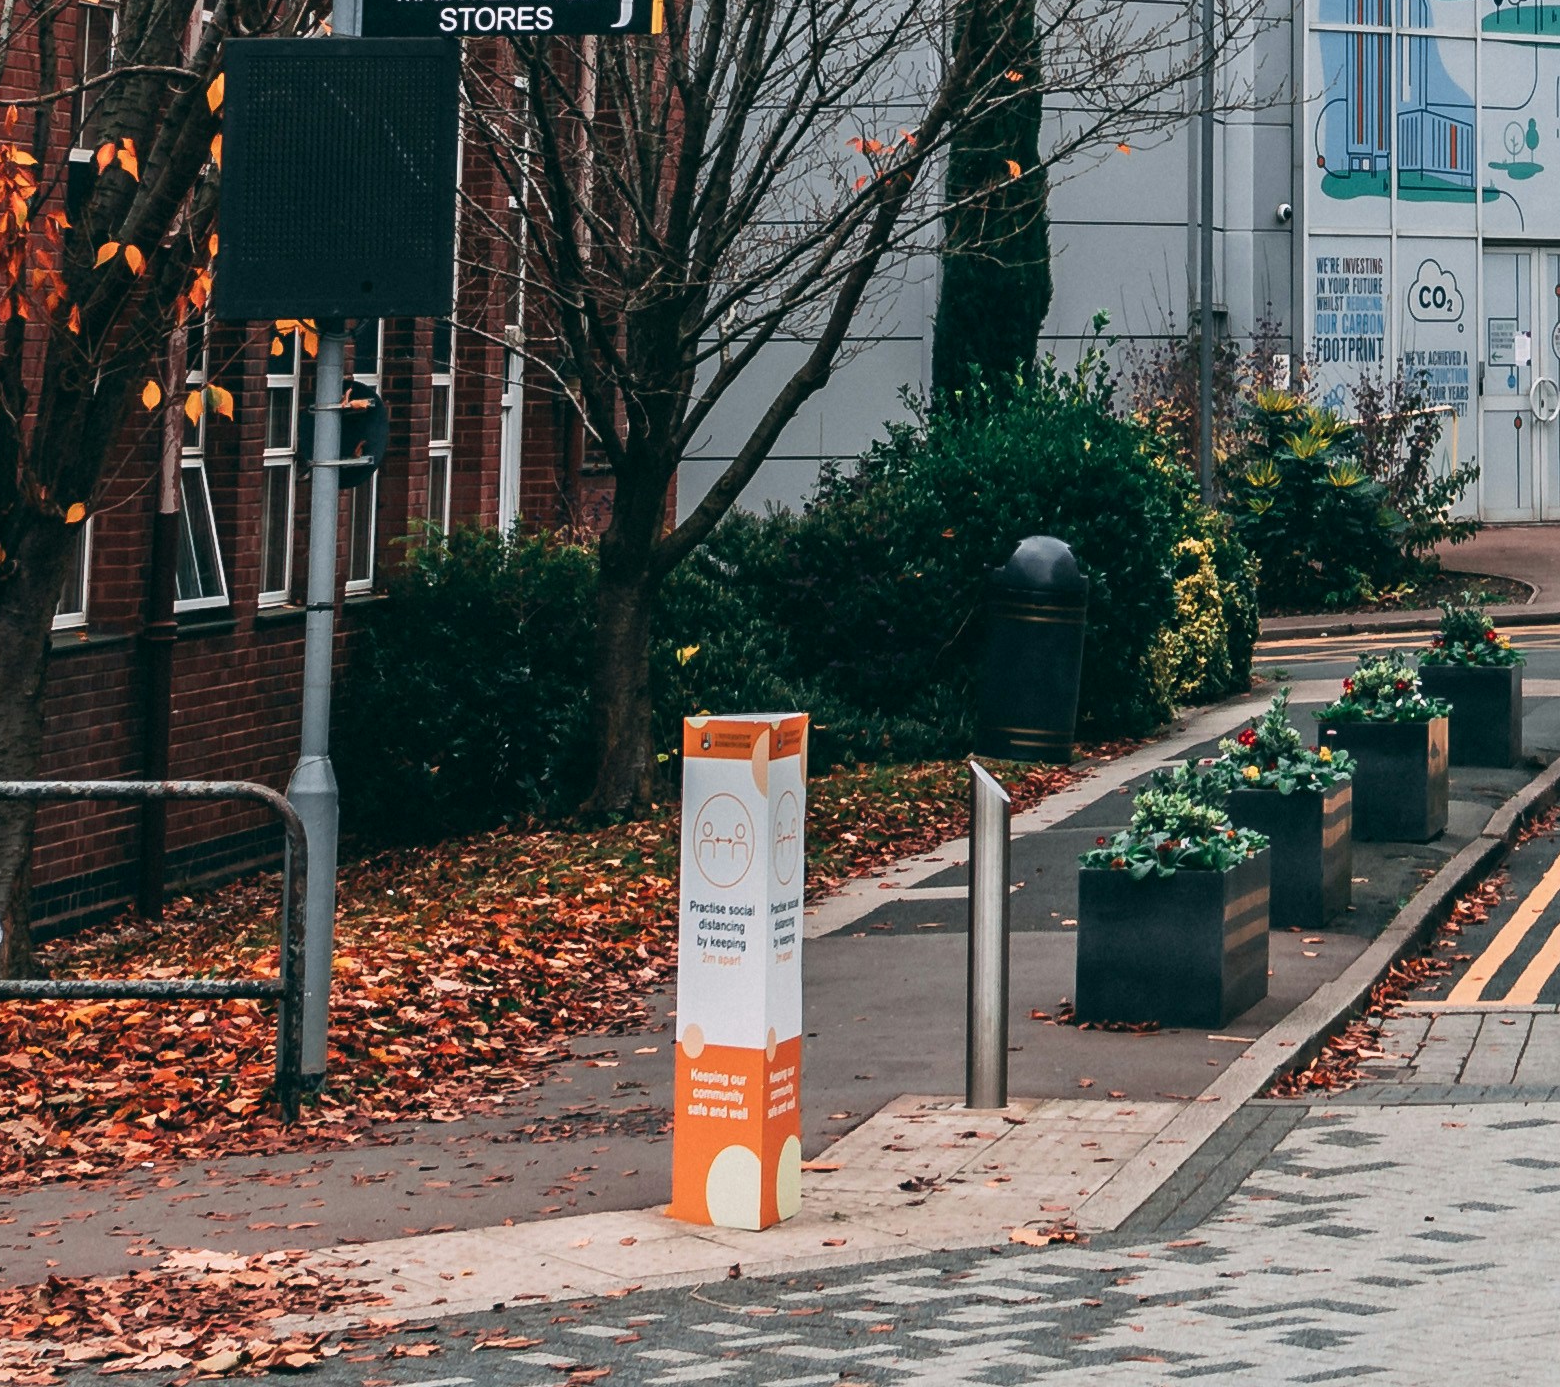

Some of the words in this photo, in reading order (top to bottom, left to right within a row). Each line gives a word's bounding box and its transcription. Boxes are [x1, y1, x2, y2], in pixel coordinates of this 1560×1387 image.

[439, 6, 554, 32] STORES
[1316, 256, 1340, 274] WE'RE
[1342, 257, 1383, 274] INVESTING
[1316, 277, 1326, 295] IN
[1328, 277, 1350, 294] YOUR
[1352, 277, 1383, 294] FUTURE
[1316, 295, 1344, 311] WHILST
[1346, 295, 1382, 311] REDUCING
[1316, 313, 1338, 334] OUR
[1341, 313, 1384, 334] CARBON
[1315, 337, 1384, 363] FOOTPRINT
[1428, 351, 1461, 366] ACHIEVED
[1463, 351, 1468, 366] A
[1448, 386, 1469, 401] YEARS
[690, 900, 726, 915] Practise
[728, 904, 756, 917] social
[698, 918, 745, 936] distancing
[696, 934, 708, 949] by
[710, 935, 746, 952] keeping
[702, 951, 716, 963] 2m
[718, 953, 742, 966] apart
[690, 1068, 729, 1087] Keeping
[730, 1074, 747, 1086] our
[692, 1088, 745, 1106] community
[687, 1102, 708, 1117] safe
[709, 1105, 728, 1119] and
[729, 1107, 748, 1120] well
